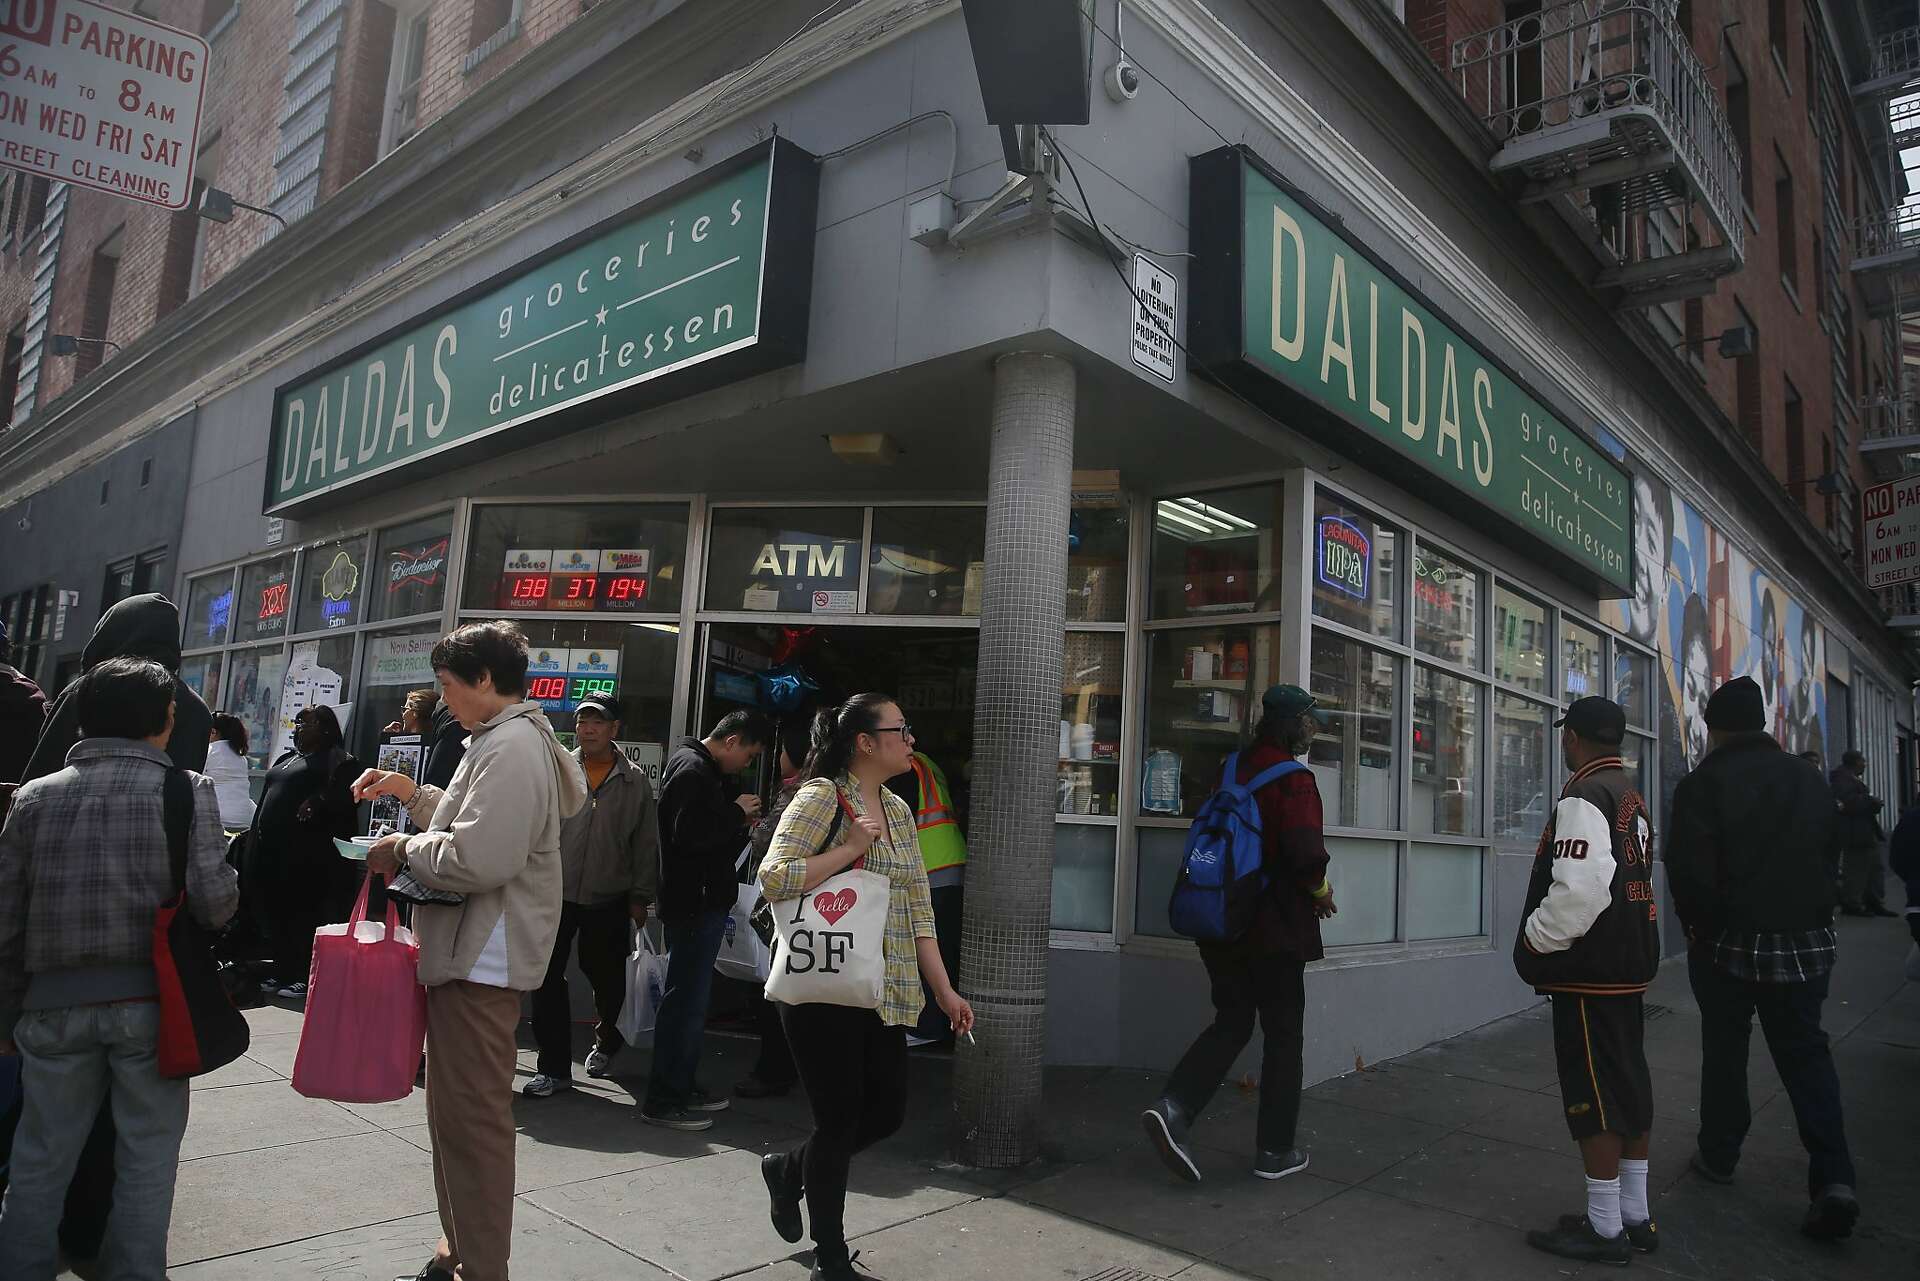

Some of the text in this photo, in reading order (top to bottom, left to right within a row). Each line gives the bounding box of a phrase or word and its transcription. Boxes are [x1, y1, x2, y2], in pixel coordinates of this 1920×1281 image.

[0, 0, 195, 83] O PARKING
[78, 85, 95, 100] TO
[0, 90, 182, 168] ON WED FRI SAT
[0, 138, 59, 169] REET
[72, 159, 170, 199] CLEANING
[499, 199, 743, 338] groceries
[1151, 277, 1161, 294] NO
[1137, 286, 1174, 320] LOITERING
[1135, 321, 1172, 354] PROPERTY
[1272, 204, 1494, 487] DALDAS
[488, 302, 733, 416] delicatessen
[280, 324, 458, 493] DALDAS
[1521, 412, 1622, 505] groceries
[1866, 488, 1890, 517] NO
[1322, 523, 1368, 557] LAGUNITAS
[1521, 479, 1623, 573] delicatessen
[391, 557, 443, 580] Budweiser
[750, 543, 845, 578] ATM
[1326, 540, 1363, 588] IPA
[1871, 541, 1917, 565] MON WED
[513, 578, 548, 598] 138
[567, 578, 596, 598] 37
[608, 578, 646, 598] 194
[1874, 568, 1908, 584] STREET
[259, 583, 288, 618] XX
[510, 599, 538, 608] MILLION
[558, 600, 586, 608] MILLION
[606, 600, 636, 608] MILLION
[390, 640, 407, 654] Now
[624, 746, 641, 761] NO
[790, 893, 850, 925] I hella
[785, 929, 853, 975] SF
